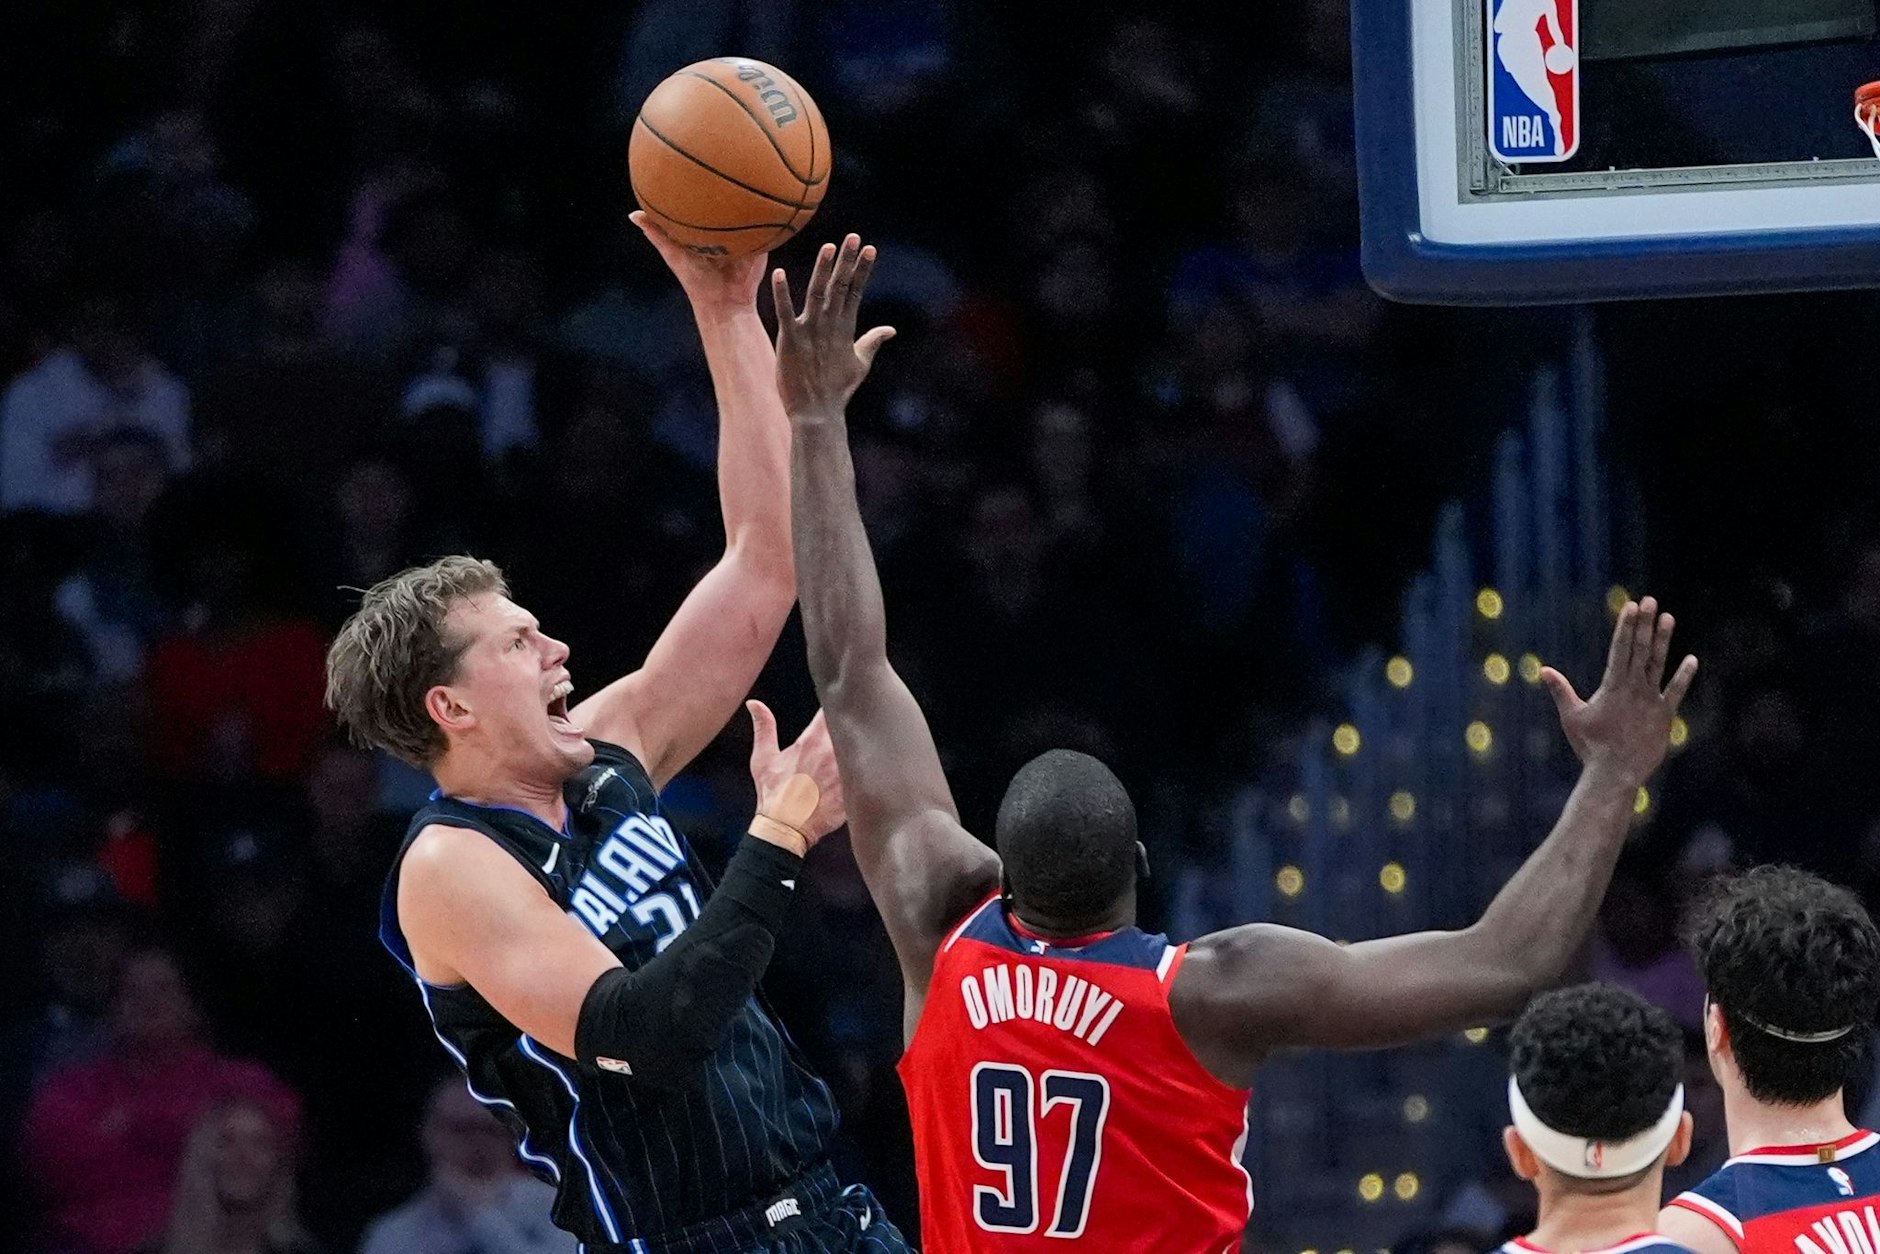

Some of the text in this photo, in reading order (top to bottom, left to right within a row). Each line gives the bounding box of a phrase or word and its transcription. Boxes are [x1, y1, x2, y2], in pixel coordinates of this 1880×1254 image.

[738, 64, 797, 129] Wil
[1502, 115, 1545, 148] NBA
[960, 964, 1124, 1046] OMORUYI
[970, 1061, 1110, 1239] 97
